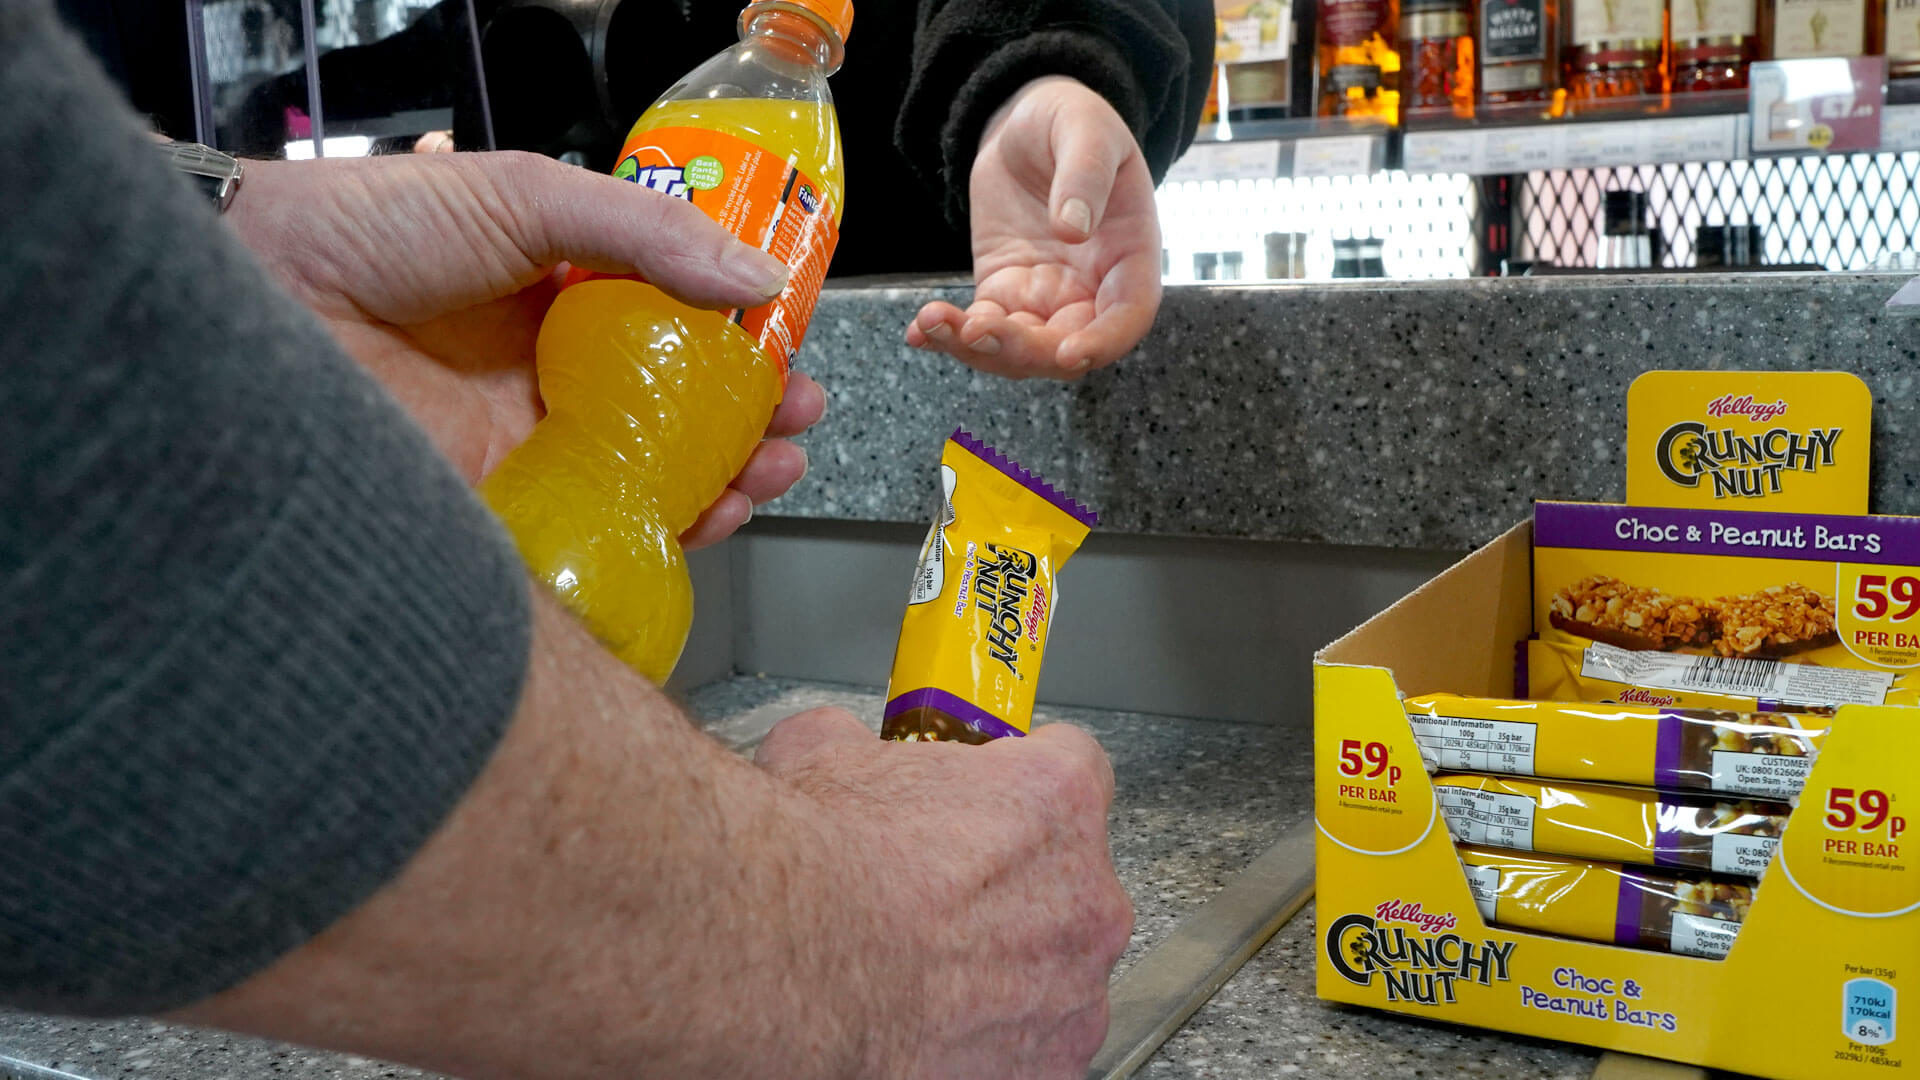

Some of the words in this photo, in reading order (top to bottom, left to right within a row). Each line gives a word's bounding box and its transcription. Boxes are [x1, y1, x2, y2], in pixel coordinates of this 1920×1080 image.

[691, 173, 716, 181] Taste
[692, 166, 718, 174] Fanta
[1707, 394, 1788, 422] Kellogg's
[1656, 421, 1841, 487] CRUNCHY
[1710, 462, 1783, 498] NUT
[1615, 518, 1679, 543] Choc
[1686, 525, 1701, 542] &
[1710, 522, 1807, 549] Peanut
[1814, 525, 1881, 553] Bars
[959, 569, 973, 601] Peanut
[974, 556, 1000, 620] NUT
[954, 601, 967, 618] Bar
[1025, 583, 1047, 642] Kellogg's
[1854, 630, 1889, 646] PER
[1894, 633, 1920, 648] BA
[1411, 716, 1449, 726] Nutritional
[1451, 719, 1494, 729] Information
[1460, 729, 1475, 739] 100g
[1498, 732, 1510, 742] 35g
[1511, 733, 1522, 741] bar
[1466, 740, 1487, 750] 485kcal
[1508, 743, 1530, 753] 170kcal
[1736, 765, 1750, 773] UK:
[1751, 766, 1773, 775] 0800
[1761, 757, 1809, 768] CUSTOMER
[1738, 774, 1760, 784] Open
[1762, 776, 1781, 785] 9am
[1338, 784, 1365, 799] PER
[1368, 788, 1397, 803] BAR
[1460, 798, 1475, 809] 100g
[1498, 805, 1509, 816] 35g
[1510, 806, 1521, 815] bar
[1507, 816, 1529, 826] 170kcal
[1736, 847, 1750, 855] UK:
[1824, 839, 1857, 854] PER
[1862, 842, 1899, 858] BAR
[1738, 856, 1761, 867] Open
[1375, 899, 1458, 933] Kellogg's
[1326, 914, 1516, 985] CRUNCHY
[1696, 937, 1719, 949] Open
[1845, 963, 1858, 973] Per
[1860, 965, 1873, 975] bar
[1875, 967, 1896, 979] (35g)
[1382, 970, 1458, 1004] NUT
[1553, 967, 1615, 994] Choc
[1623, 979, 1642, 999] &
[1520, 986, 1608, 1019] Peanut
[1614, 1000, 1677, 1032] Bars
[1854, 995, 1886, 1008] 710kJ
[1849, 1006, 1891, 1019] 170kcal
[1849, 1042, 1862, 1052] Per
[1834, 1051, 1863, 1062] 2029kJ
[1870, 1056, 1902, 1068] 485kcal
